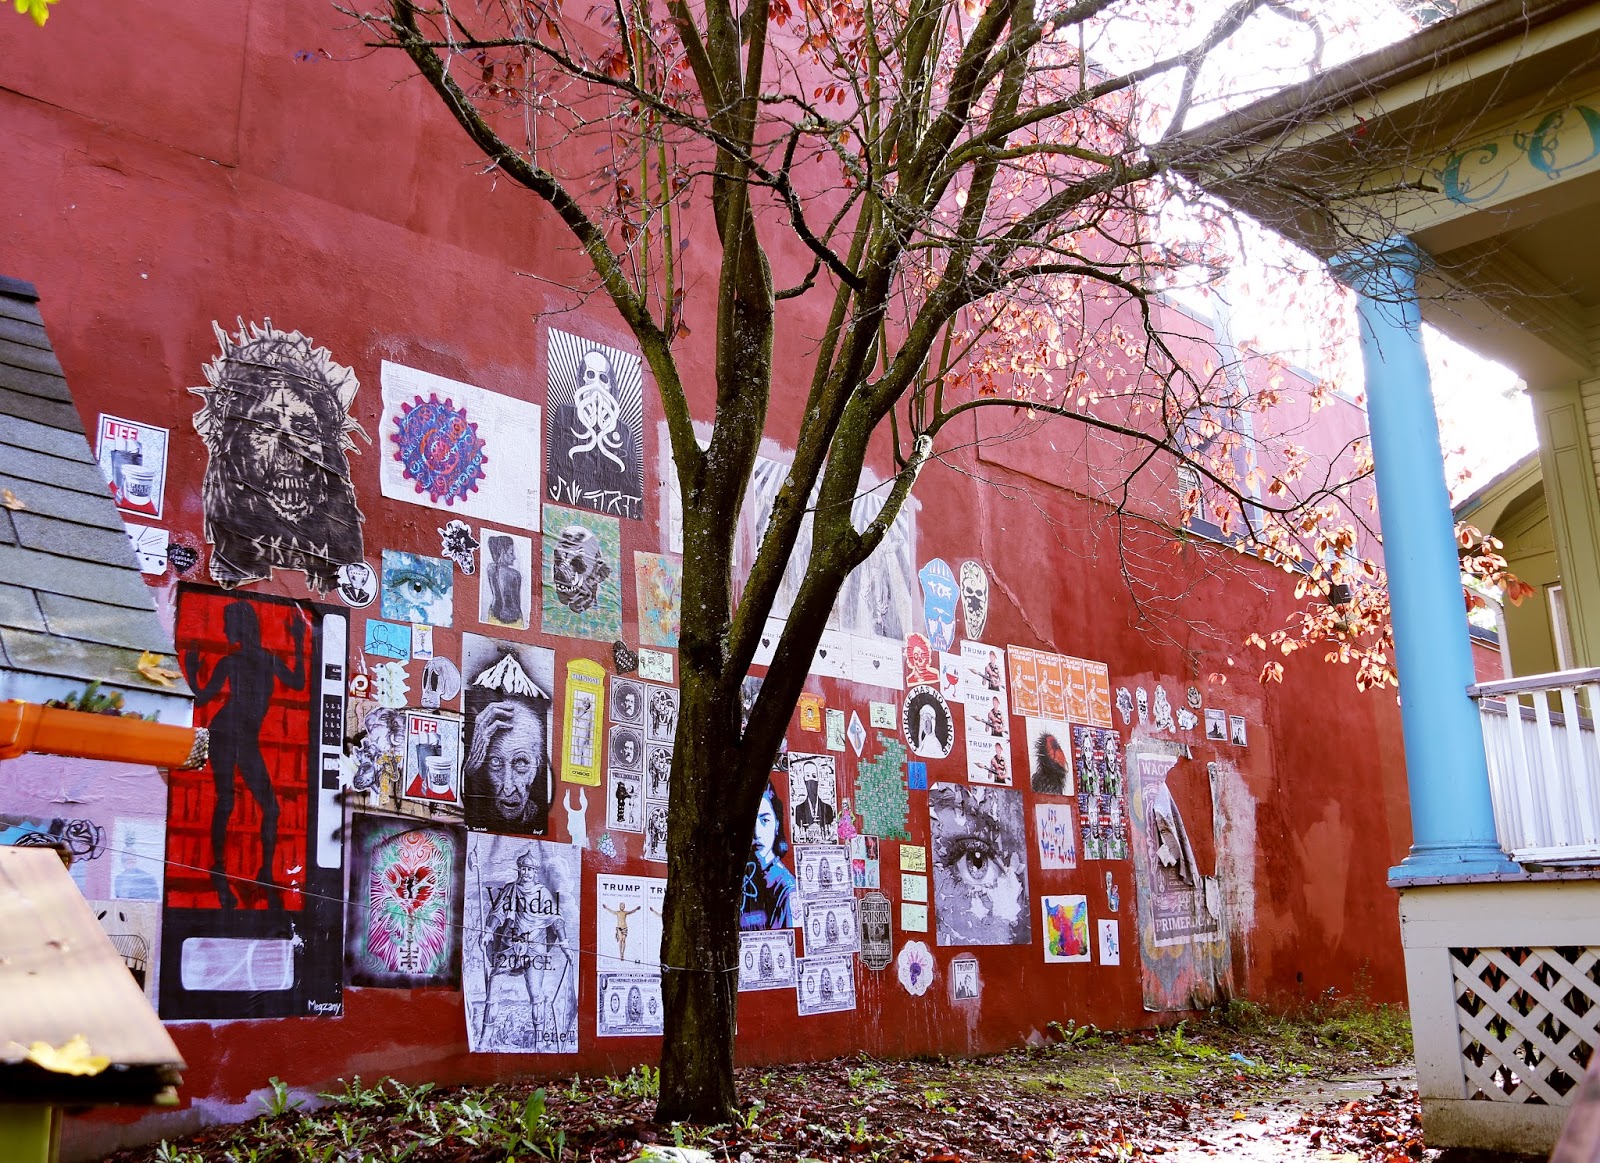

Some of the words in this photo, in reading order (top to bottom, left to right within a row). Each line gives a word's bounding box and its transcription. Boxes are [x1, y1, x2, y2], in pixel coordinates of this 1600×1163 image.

[105, 421, 138, 440] LIFE
[963, 646, 987, 656] TRUMP
[914, 685, 930, 696] HAS
[932, 688, 944, 704] NO
[966, 693, 990, 702] TRUMP
[411, 718, 437, 734] LIFE
[968, 740, 993, 749] TRUMP
[603, 883, 641, 892] TRUMP
[486, 887, 561, 916] Vandal
[862, 911, 889, 923] POISON
